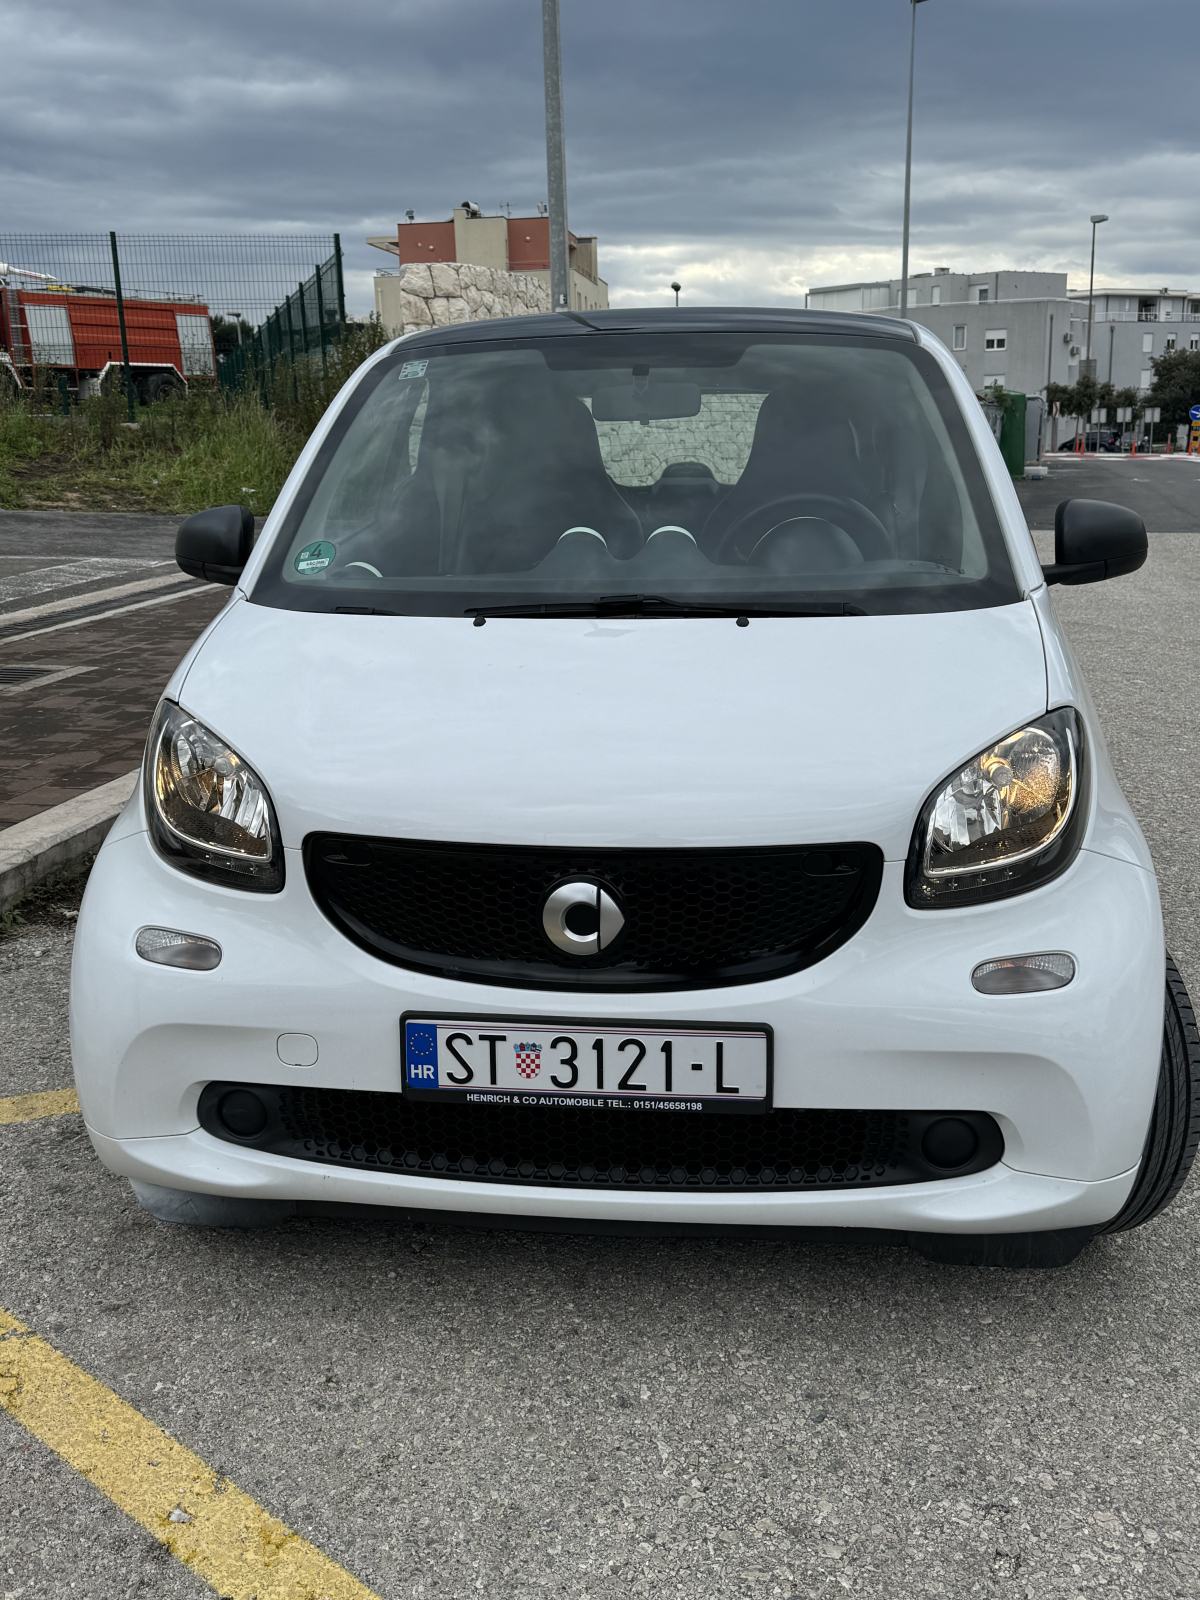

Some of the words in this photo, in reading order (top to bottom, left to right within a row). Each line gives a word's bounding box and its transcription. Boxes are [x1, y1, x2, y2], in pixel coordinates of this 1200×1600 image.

[310, 543, 322, 557] 4
[410, 1063, 435, 1080] HR
[445, 1032, 507, 1085] ST
[549, 1035, 740, 1094] 3121-L
[466, 1093, 511, 1103] HENRICH
[513, 1095, 520, 1104] &
[522, 1096, 537, 1105] CO
[539, 1096, 604, 1107] AUTOMOBILE
[606, 1099, 631, 1108] TEL.:
[633, 1100, 703, 1111] 0151/45658198
